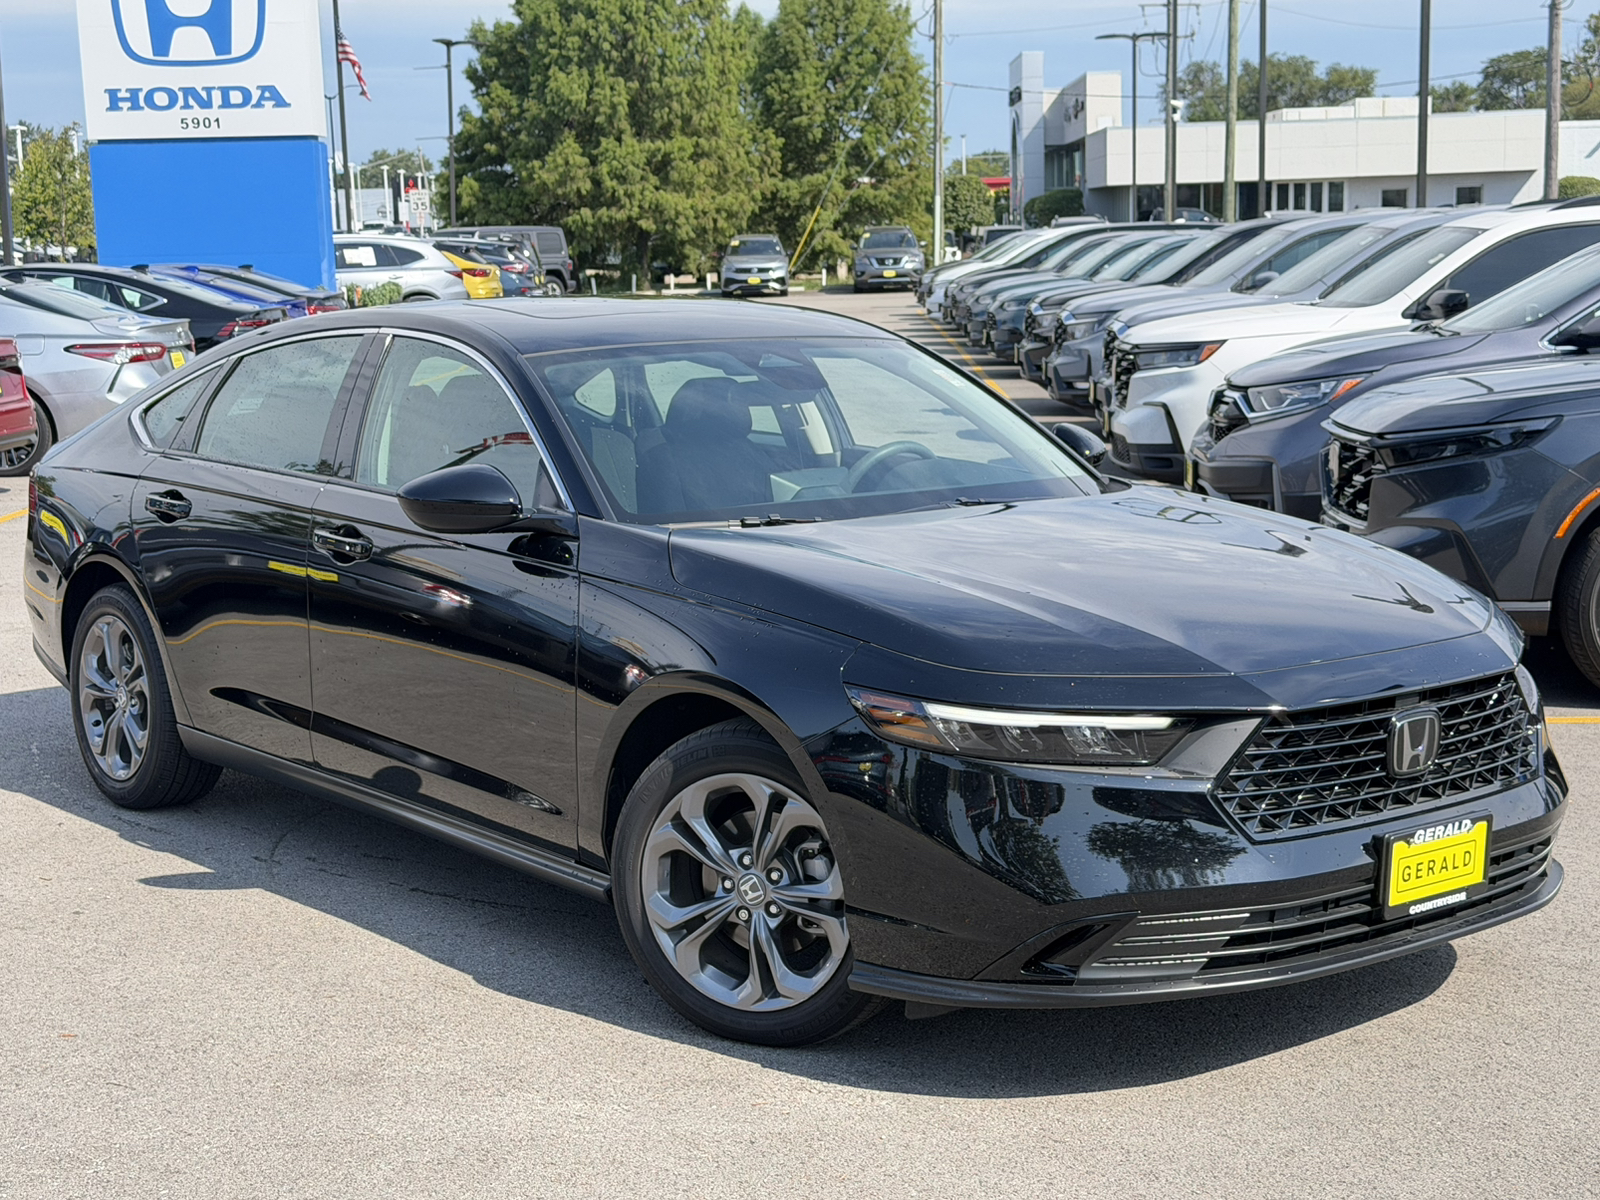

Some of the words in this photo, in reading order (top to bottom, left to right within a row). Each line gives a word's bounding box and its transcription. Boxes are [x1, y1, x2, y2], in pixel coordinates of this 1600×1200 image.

[104, 85, 291, 112] HONDA
[180, 117, 221, 130] 5901
[412, 202, 428, 211] 35
[1414, 820, 1471, 844] GERALD
[1402, 851, 1472, 882] GERALD
